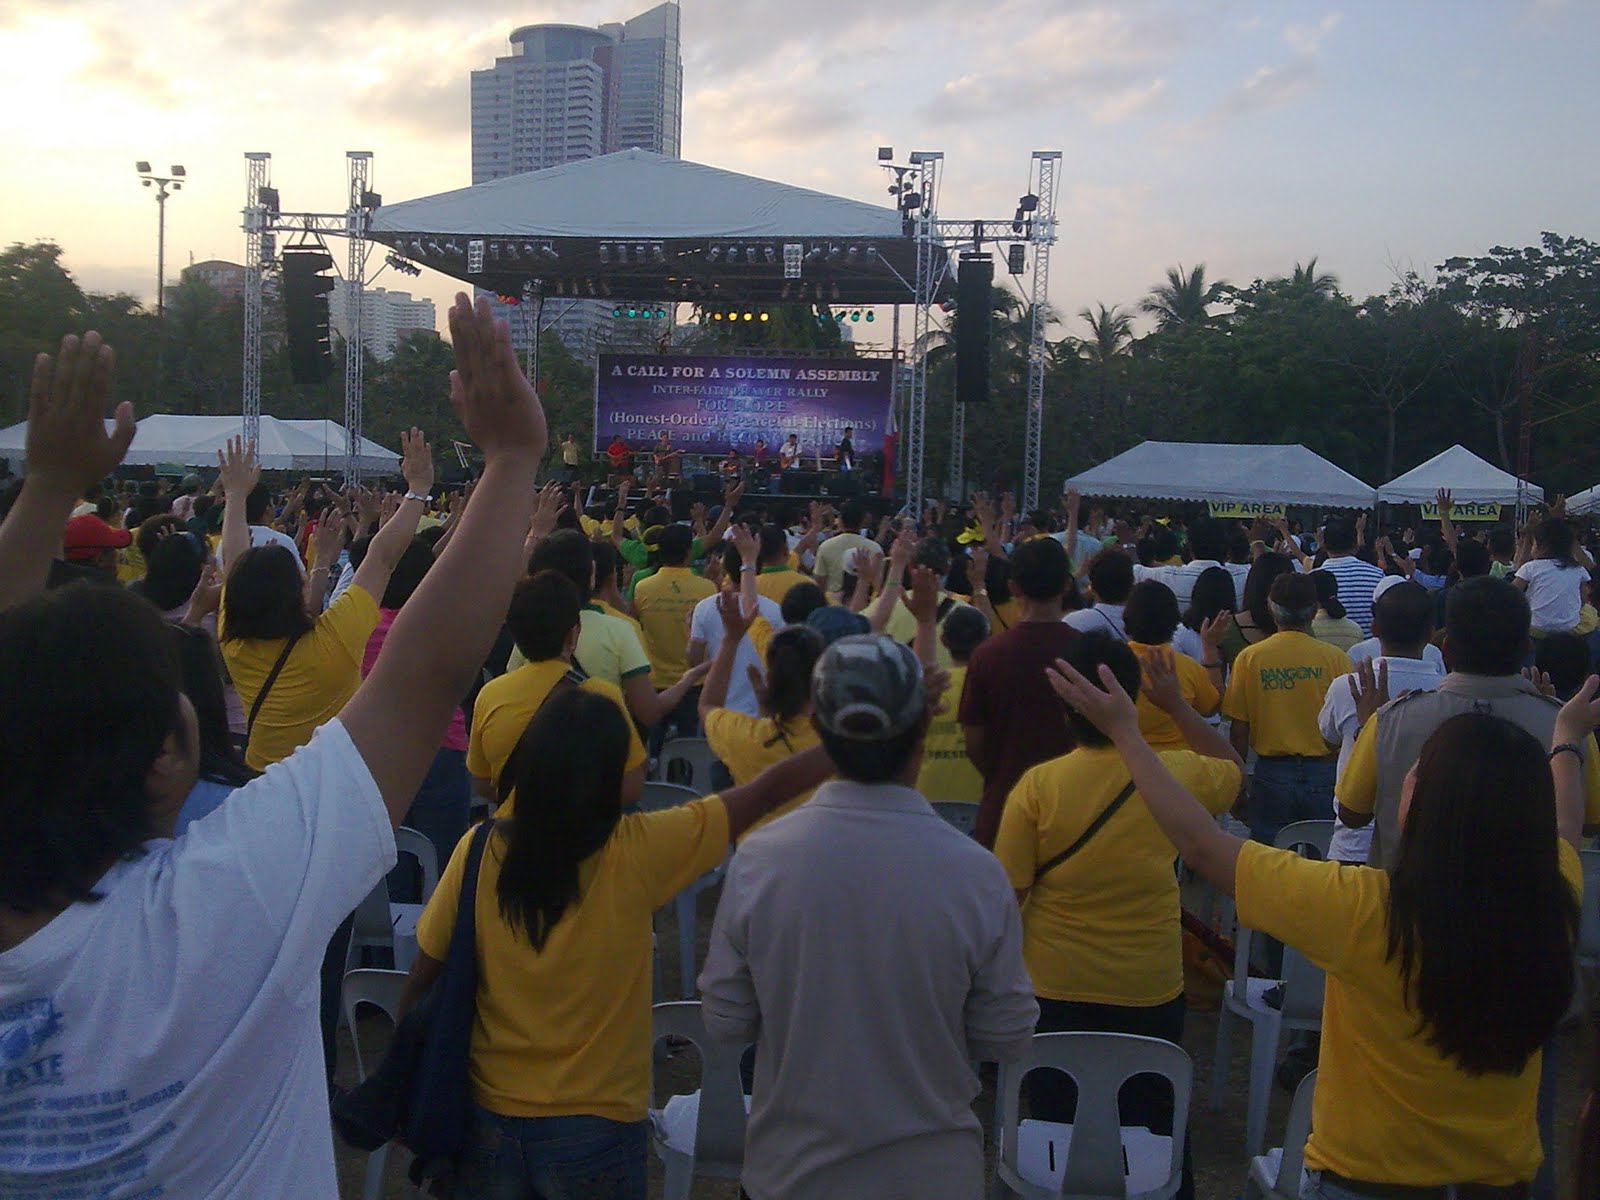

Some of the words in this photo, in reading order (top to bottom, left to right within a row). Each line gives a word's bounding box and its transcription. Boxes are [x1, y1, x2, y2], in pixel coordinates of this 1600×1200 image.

[611, 365, 623, 377] A
[627, 365, 668, 378] CALL
[672, 366, 704, 378] FOR
[708, 367, 721, 378] A
[725, 367, 792, 380] SOLEMN
[795, 369, 880, 381] ASSEMBLY
[732, 386, 782, 397] PRAYER
[787, 388, 829, 398] RALLY
[697, 399, 728, 411] FOR
[627, 428, 676, 441] PEACE
[682, 431, 711, 442] and
[1211, 502, 1236, 512] VIP
[1240, 503, 1282, 514] AREA
[1422, 504, 1448, 515] VI
[1453, 504, 1498, 515] AREA
